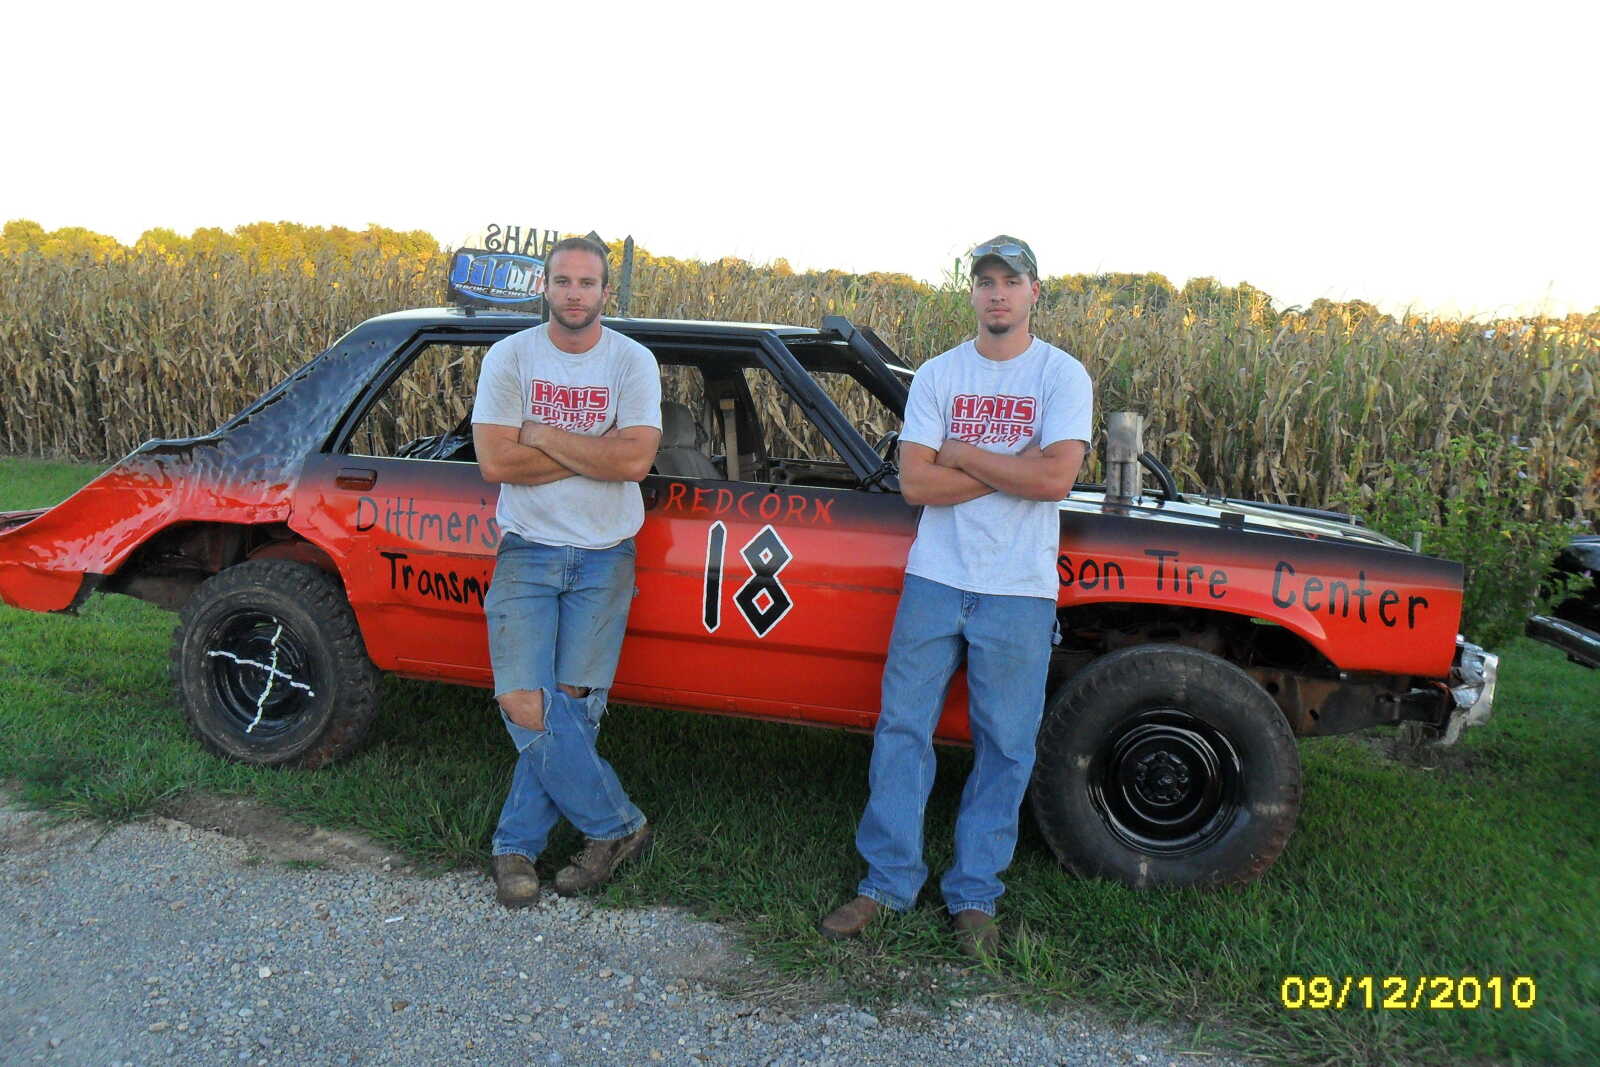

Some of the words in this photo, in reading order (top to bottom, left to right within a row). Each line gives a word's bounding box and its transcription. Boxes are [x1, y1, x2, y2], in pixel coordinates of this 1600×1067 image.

[531, 379, 609, 412] HAHS
[952, 394, 1037, 424] HAHS
[950, 421, 1034, 438] BROHERS
[356, 496, 498, 549] Dittmer's
[664, 482, 835, 524] REDCORN
[702, 520, 794, 638] 18
[1057, 554, 1126, 591] son
[1144, 549, 1228, 599] Tire
[1272, 560, 1429, 629] Center
